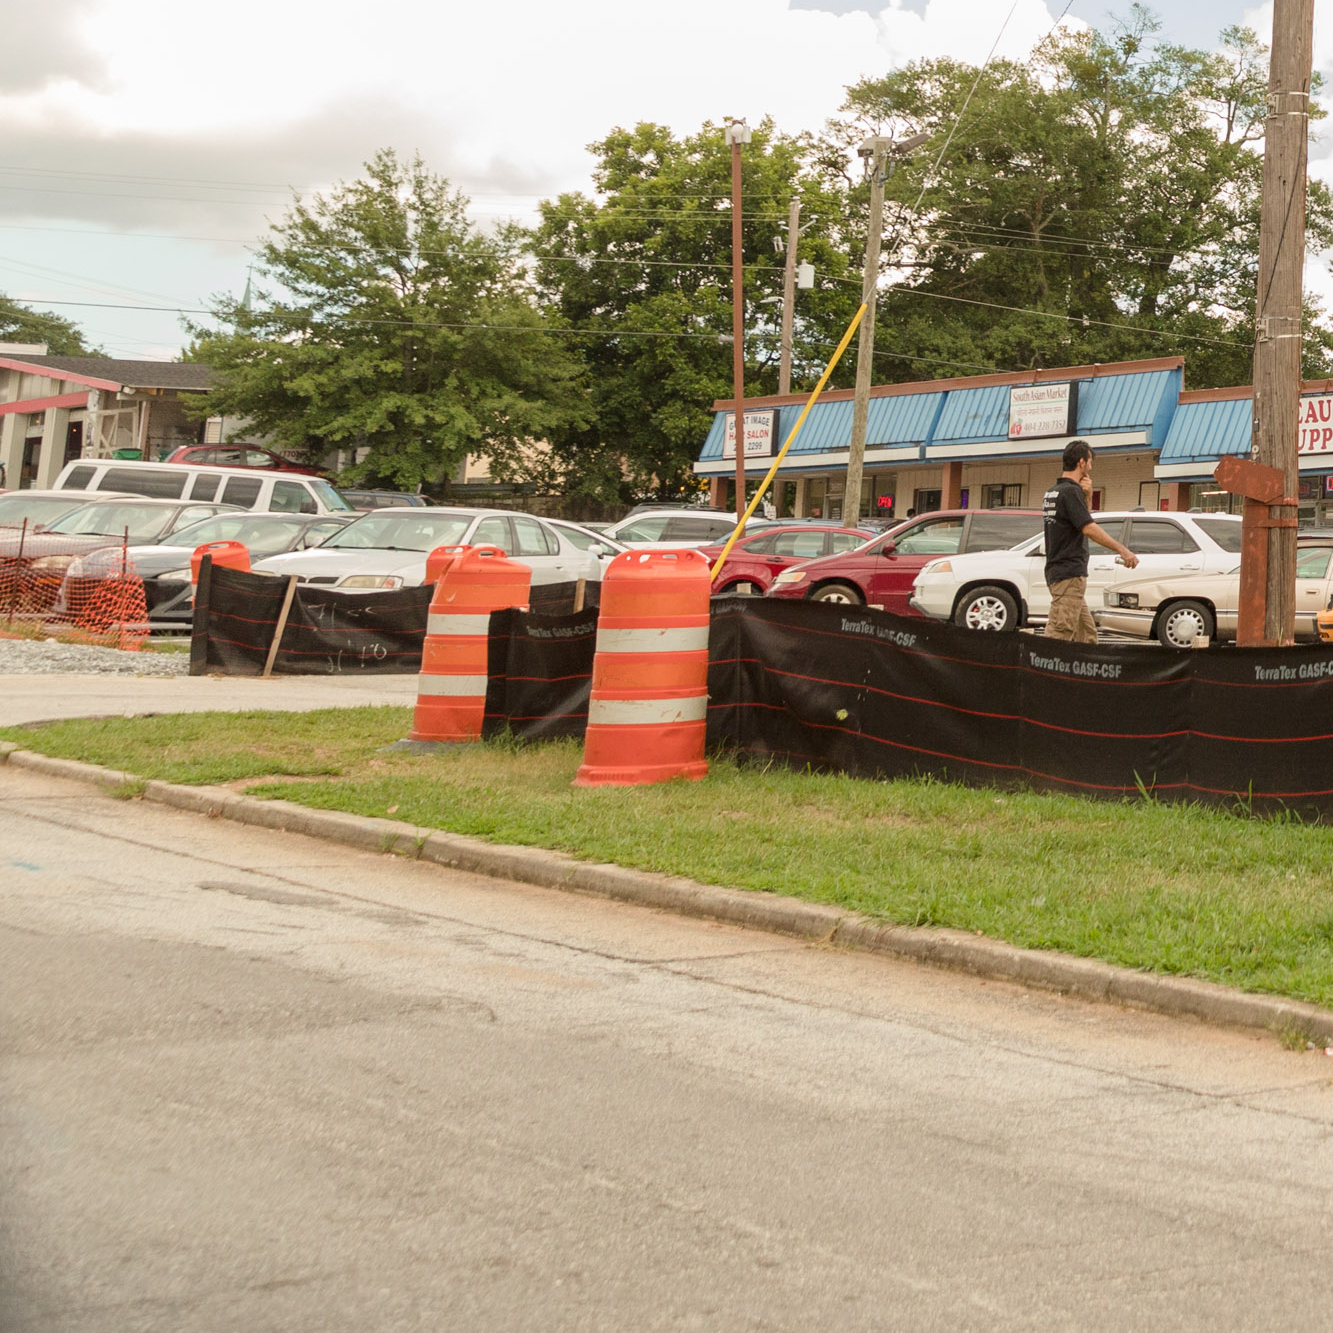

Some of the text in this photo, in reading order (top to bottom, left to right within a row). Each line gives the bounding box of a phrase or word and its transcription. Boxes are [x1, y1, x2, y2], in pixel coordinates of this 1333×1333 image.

[1013, 386, 1067, 402] South Asian Market
[751, 416, 770, 426] IMAGE
[747, 429, 769, 439] SALON
[878, 496, 892, 508] OPEN
[840, 617, 875, 636] TerraTex
[1029, 651, 1122, 679] TerraTex GASF-CSF
[1255, 664, 1297, 681] TerraTex
